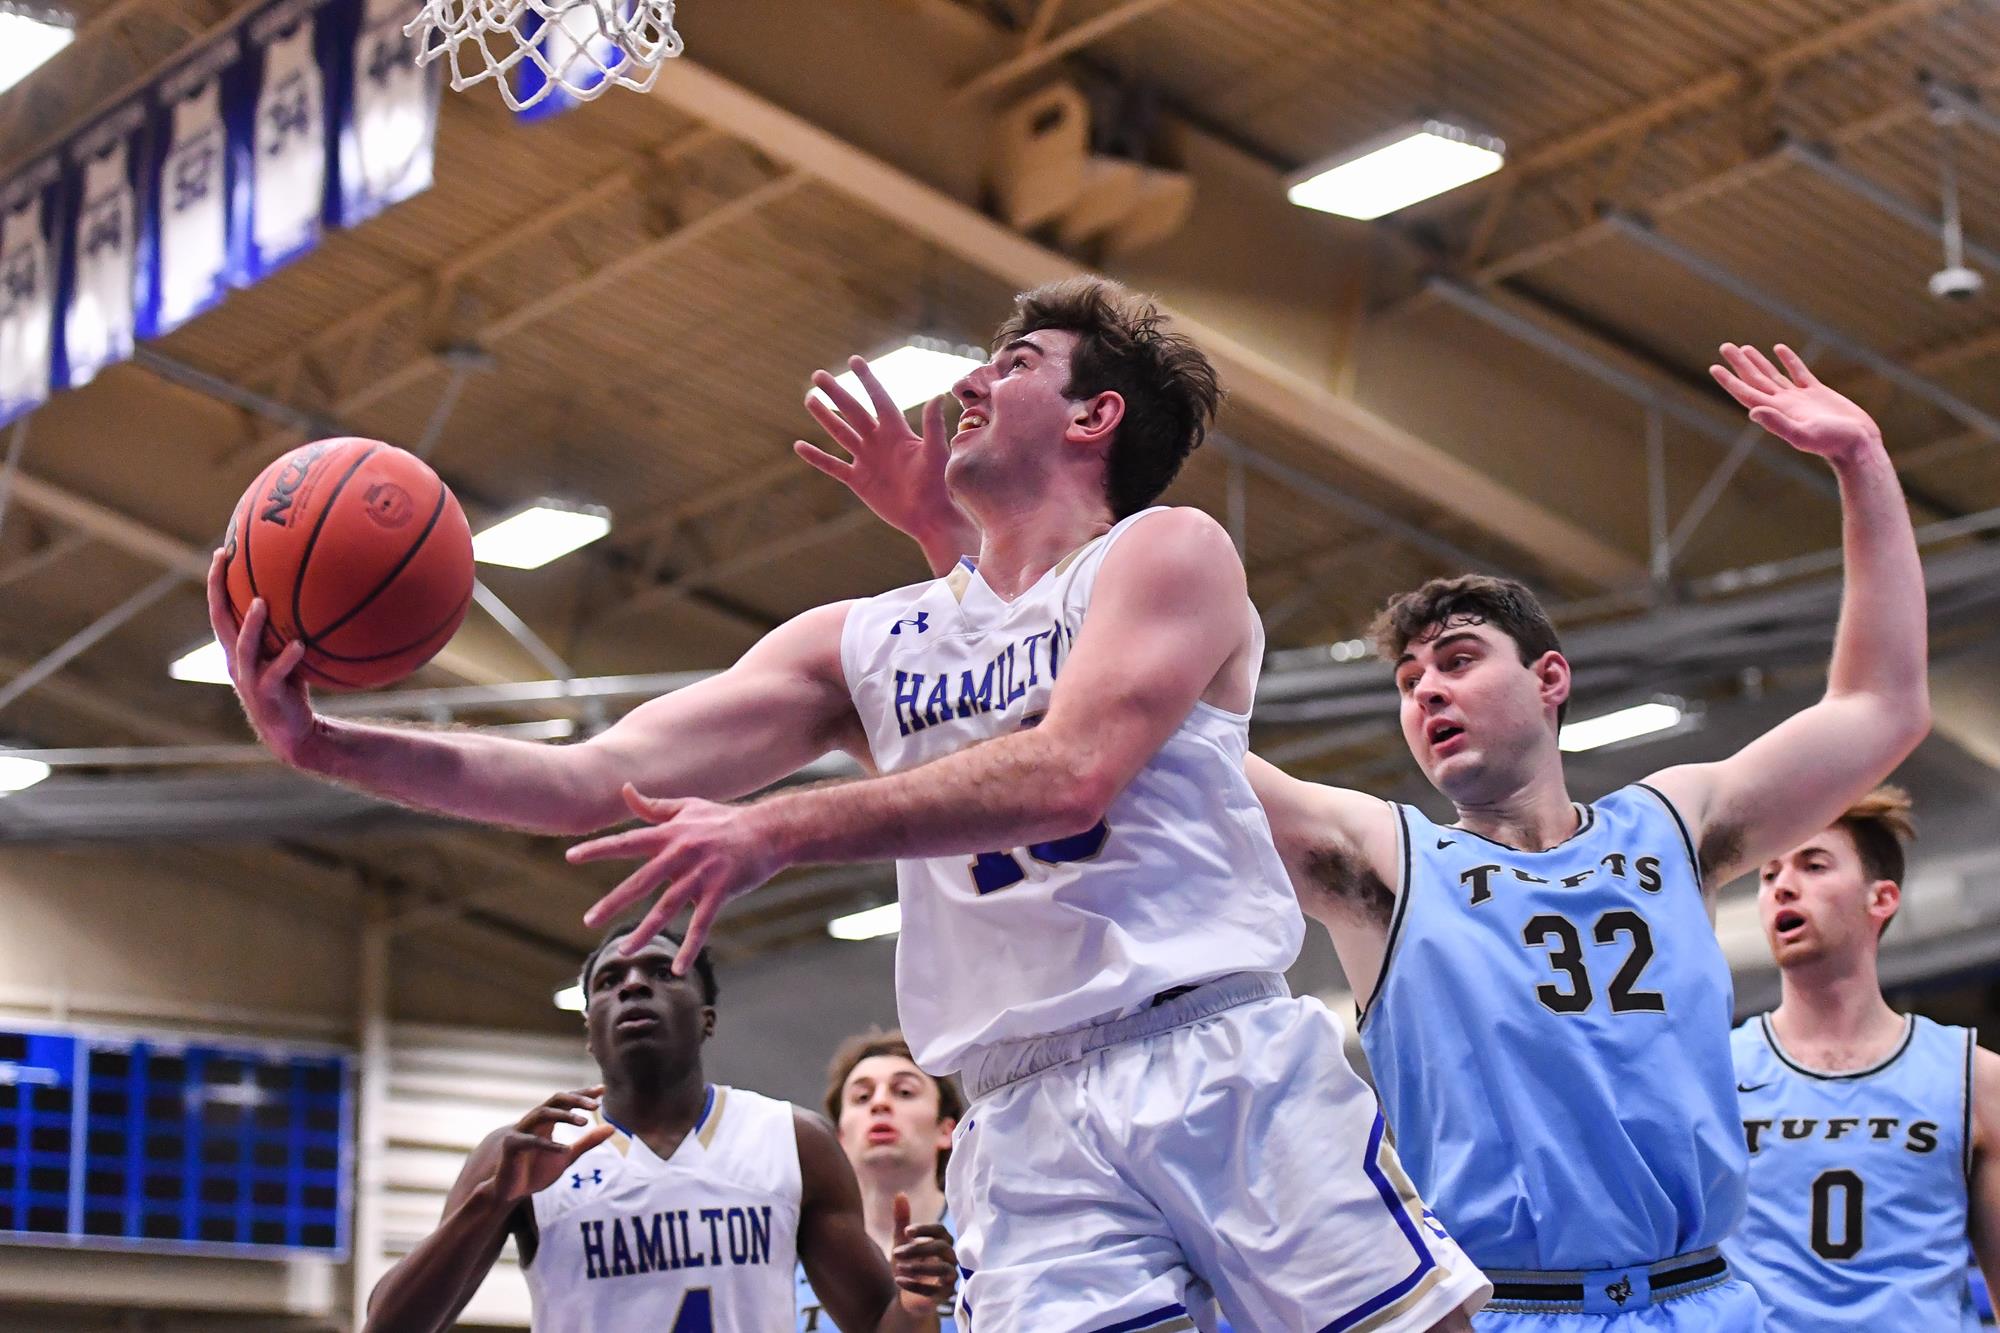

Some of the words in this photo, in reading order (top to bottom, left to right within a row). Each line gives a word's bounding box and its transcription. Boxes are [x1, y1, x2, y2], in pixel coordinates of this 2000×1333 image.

[893, 618, 1073, 738] HAMILTO
[1460, 853, 1663, 906] TUFTS
[1522, 910, 1666, 1015] 32
[1743, 1118, 1939, 1154] TUFTS
[580, 1206, 772, 1279] HAMILTON
[1810, 1168, 1864, 1261] 0
